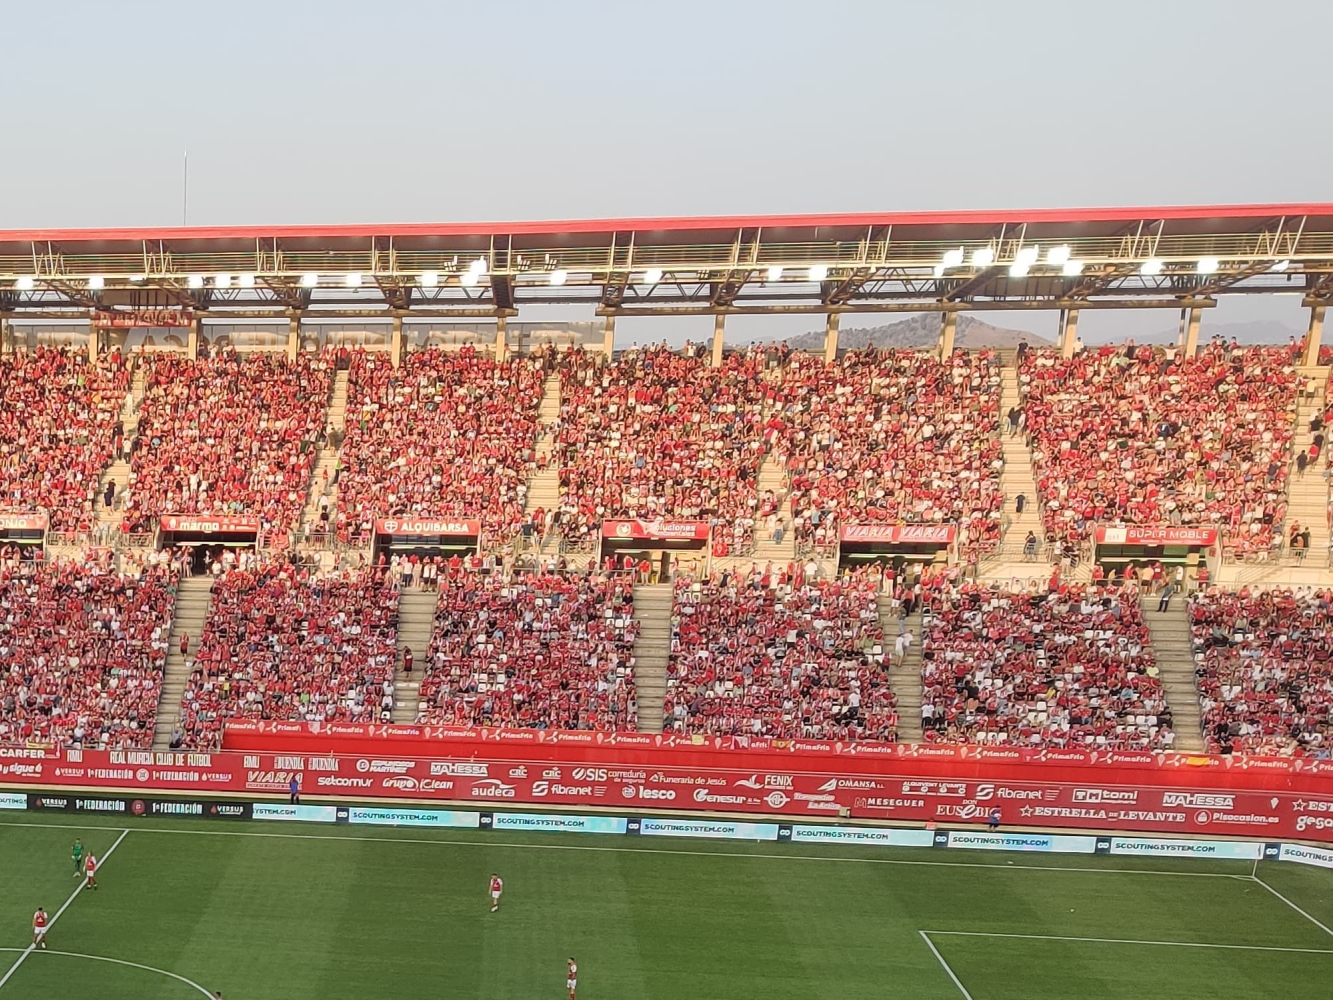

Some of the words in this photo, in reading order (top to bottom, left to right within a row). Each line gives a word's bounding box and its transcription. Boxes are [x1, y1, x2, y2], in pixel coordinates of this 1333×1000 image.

[400, 522, 469, 533] ALQUIBARSA
[846, 526, 893, 537] VIARIA
[900, 527, 949, 538] VIARIA
[617, 736, 650, 744] PrimaFrio
[795, 743, 830, 751] PrimaFrio
[856, 745, 892, 754] PrimaFrio
[919, 747, 955, 756] PrimaFrio
[128, 752, 154, 765] MURCIA
[156, 753, 173, 766] CLUB
[176, 754, 184, 766] DE
[982, 750, 1019, 758] PrimaFrio
[1047, 753, 1085, 761] PrimaFrio
[1113, 755, 1151, 763] PrimaFrio
[431, 764, 488, 775] MAHESSA
[1249, 760, 1288, 768] PrimaFrio
[585, 768, 607, 781] SIS
[659, 775, 694, 784] Funeraria
[695, 776, 705, 785] de
[317, 777, 374, 787] setcomur
[765, 775, 794, 786] FENIX
[838, 779, 876, 789] OMANSA
[471, 786, 515, 797] audeca
[551, 784, 592, 796] fibranet
[996, 787, 1044, 800] fibranet
[867, 797, 924, 807] MESEGUER
[1163, 793, 1234, 807] MAHESSA
[352, 811, 438, 822] SCOUTINGSYSTEM.COM
[1034, 806, 1107, 819] ESTRELLA
[1119, 810, 1186, 822] LEVANTE
[497, 817, 584, 828] SCOUTINGSYSTEM.COM
[644, 823, 734, 834] SCOUTINGSYSTEM.COM
[796, 830, 888, 840] SCOUTINGSYSTEM.COM
[952, 836, 1049, 847] SCOUTINGSYSTEM.COM
[1115, 842, 1215, 853] SCOUTINGSYSTEM.COM
